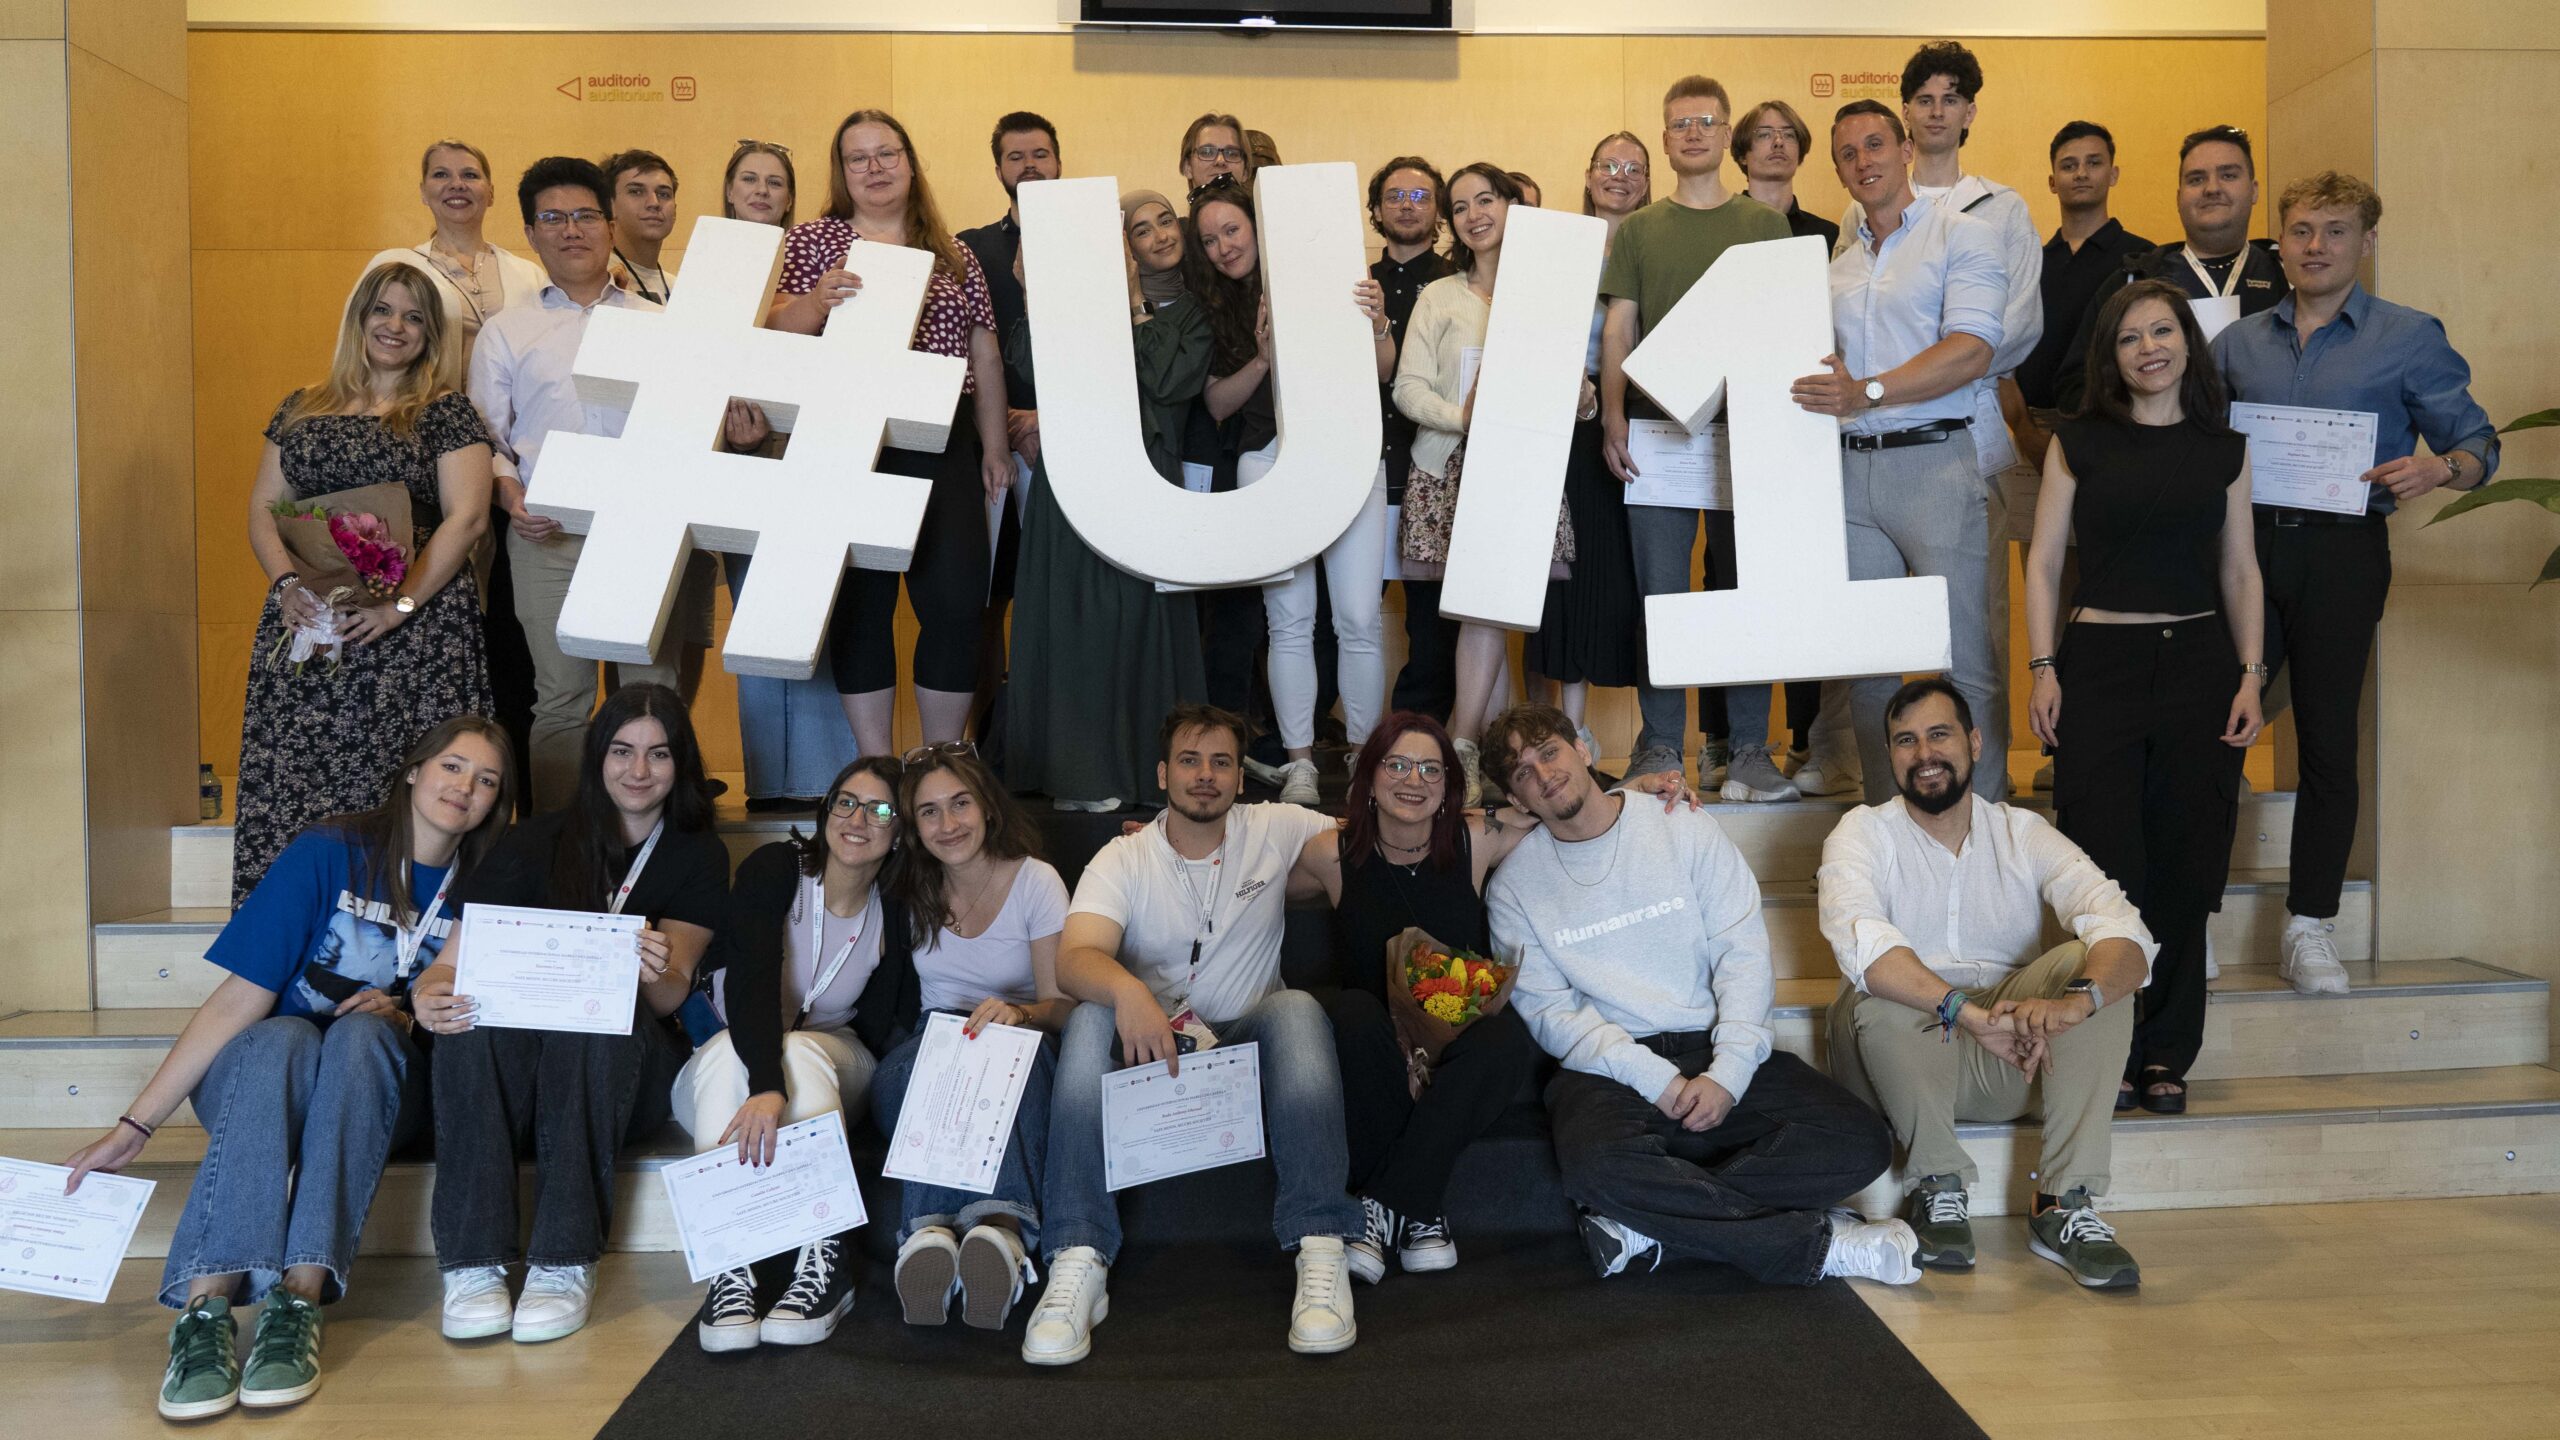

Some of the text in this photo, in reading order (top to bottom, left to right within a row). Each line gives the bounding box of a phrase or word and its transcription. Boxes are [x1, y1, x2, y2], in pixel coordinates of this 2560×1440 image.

[588, 73, 650, 87] auditorio
[1840, 71, 1899, 84] auditorio
[588, 89, 664, 102] auditorium
[1840, 86, 1902, 98] auditoriu
[1235, 880, 1266, 898] HILFIGER
[1553, 896, 1686, 948] Humanrace
